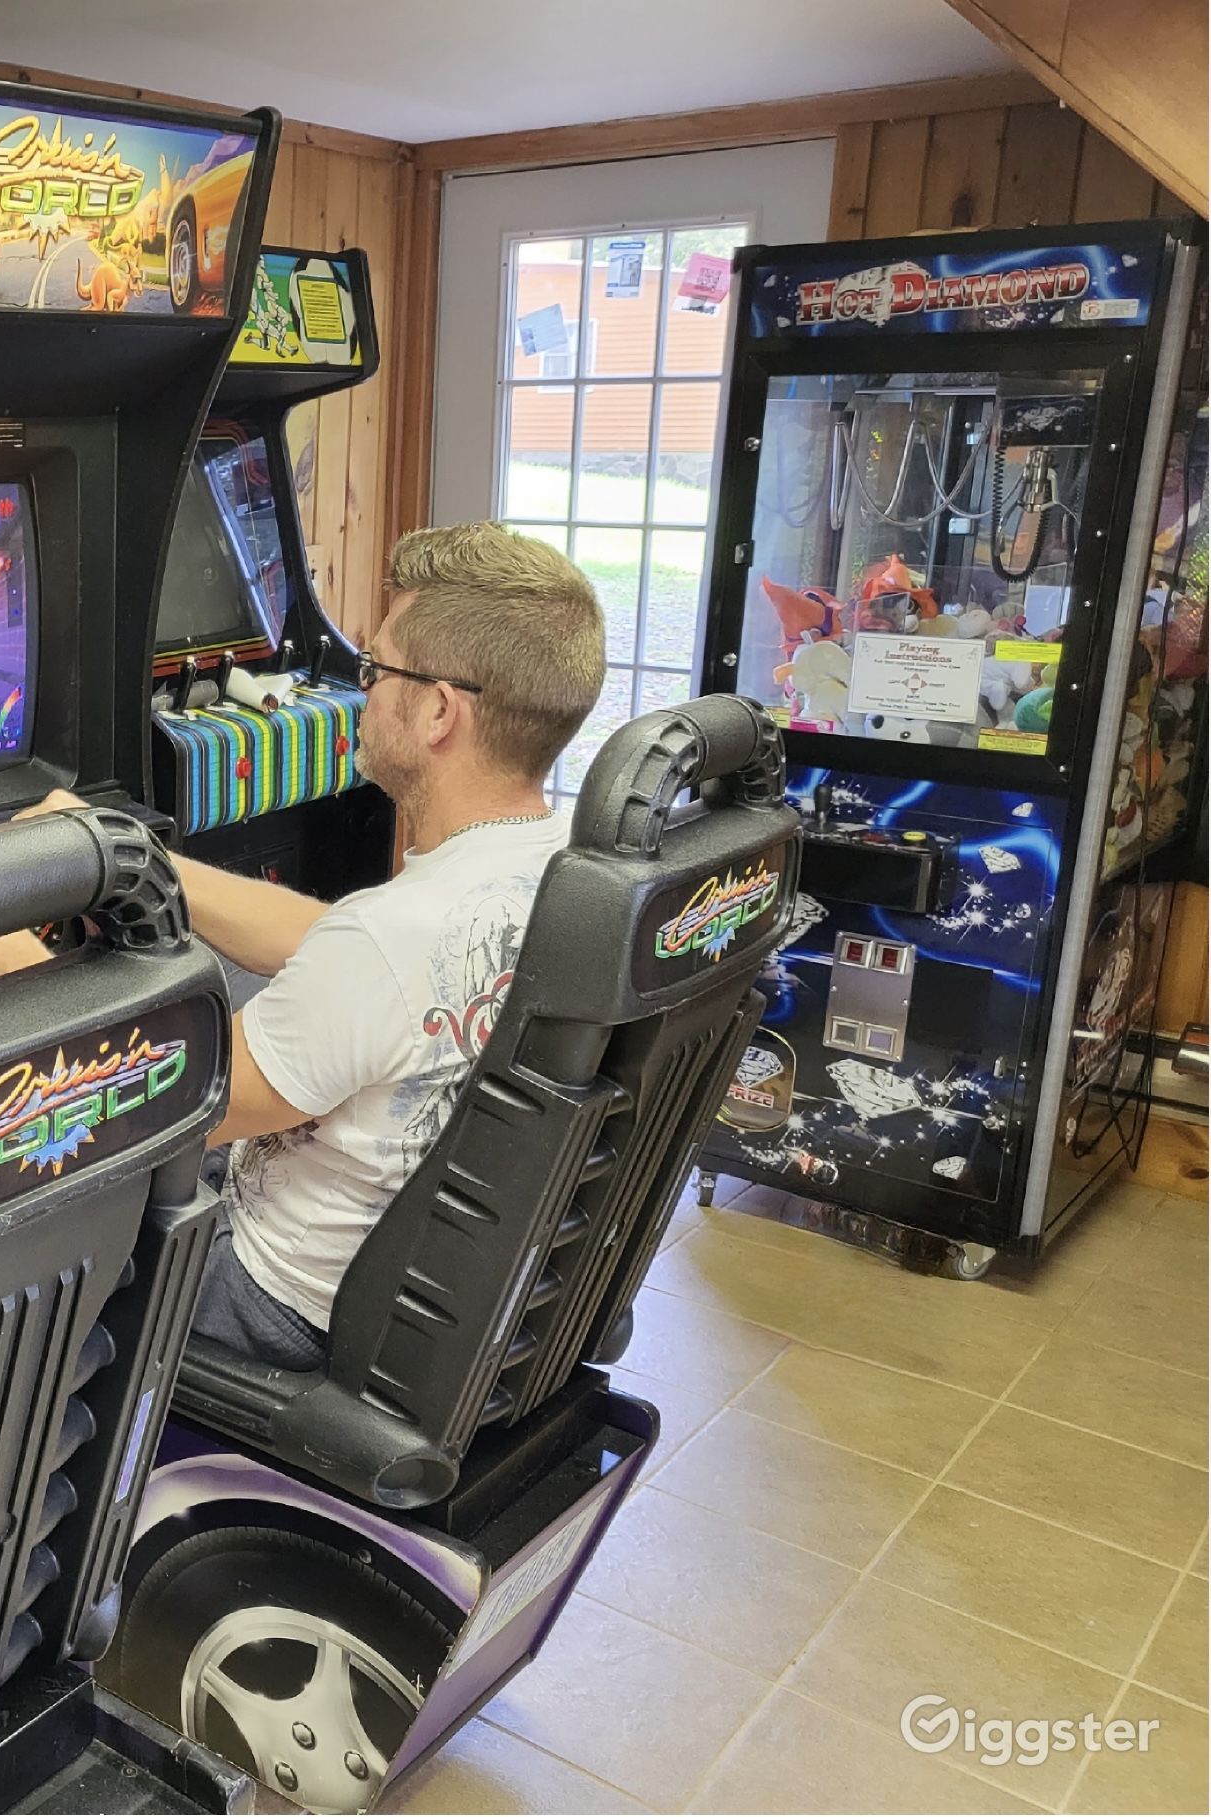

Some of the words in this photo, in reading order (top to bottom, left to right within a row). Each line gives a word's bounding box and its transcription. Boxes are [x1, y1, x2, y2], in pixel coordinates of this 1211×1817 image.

[899, 642, 941, 656] Playing
[884, 650, 953, 663] Instructions
[655, 880, 778, 959] WORLD
